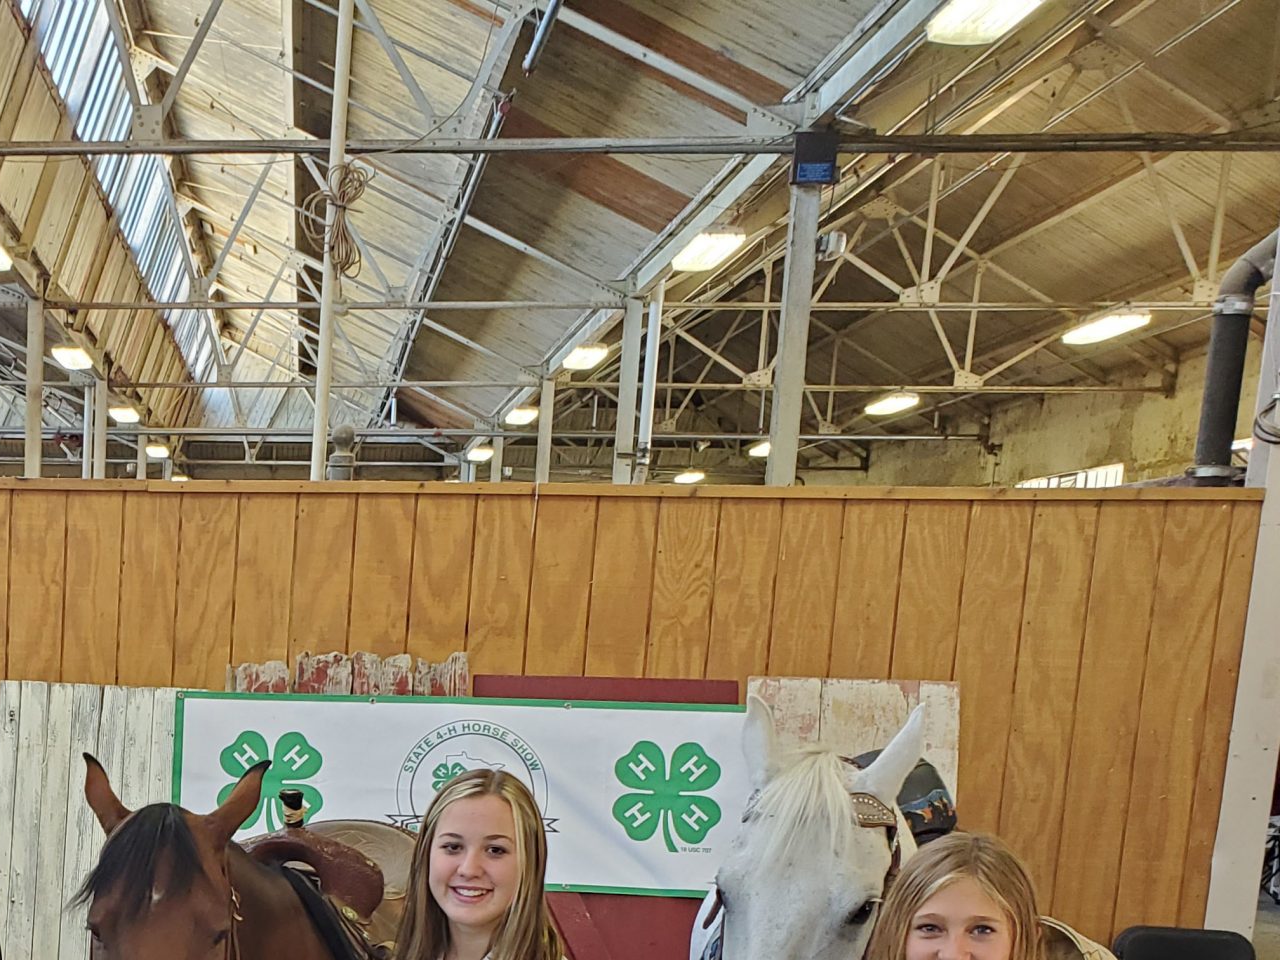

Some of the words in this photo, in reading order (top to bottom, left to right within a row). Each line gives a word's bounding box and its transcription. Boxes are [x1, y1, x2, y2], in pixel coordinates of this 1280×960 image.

[282, 744, 310, 771] H
[403, 737, 434, 773] STATE
[436, 725, 457, 740] 4-H
[462, 723, 509, 741] HORSE
[511, 738, 541, 771] SHOW
[628, 753, 656, 781] H
[680, 755, 708, 782] H
[624, 801, 652, 828] H
[681, 804, 709, 831] H
